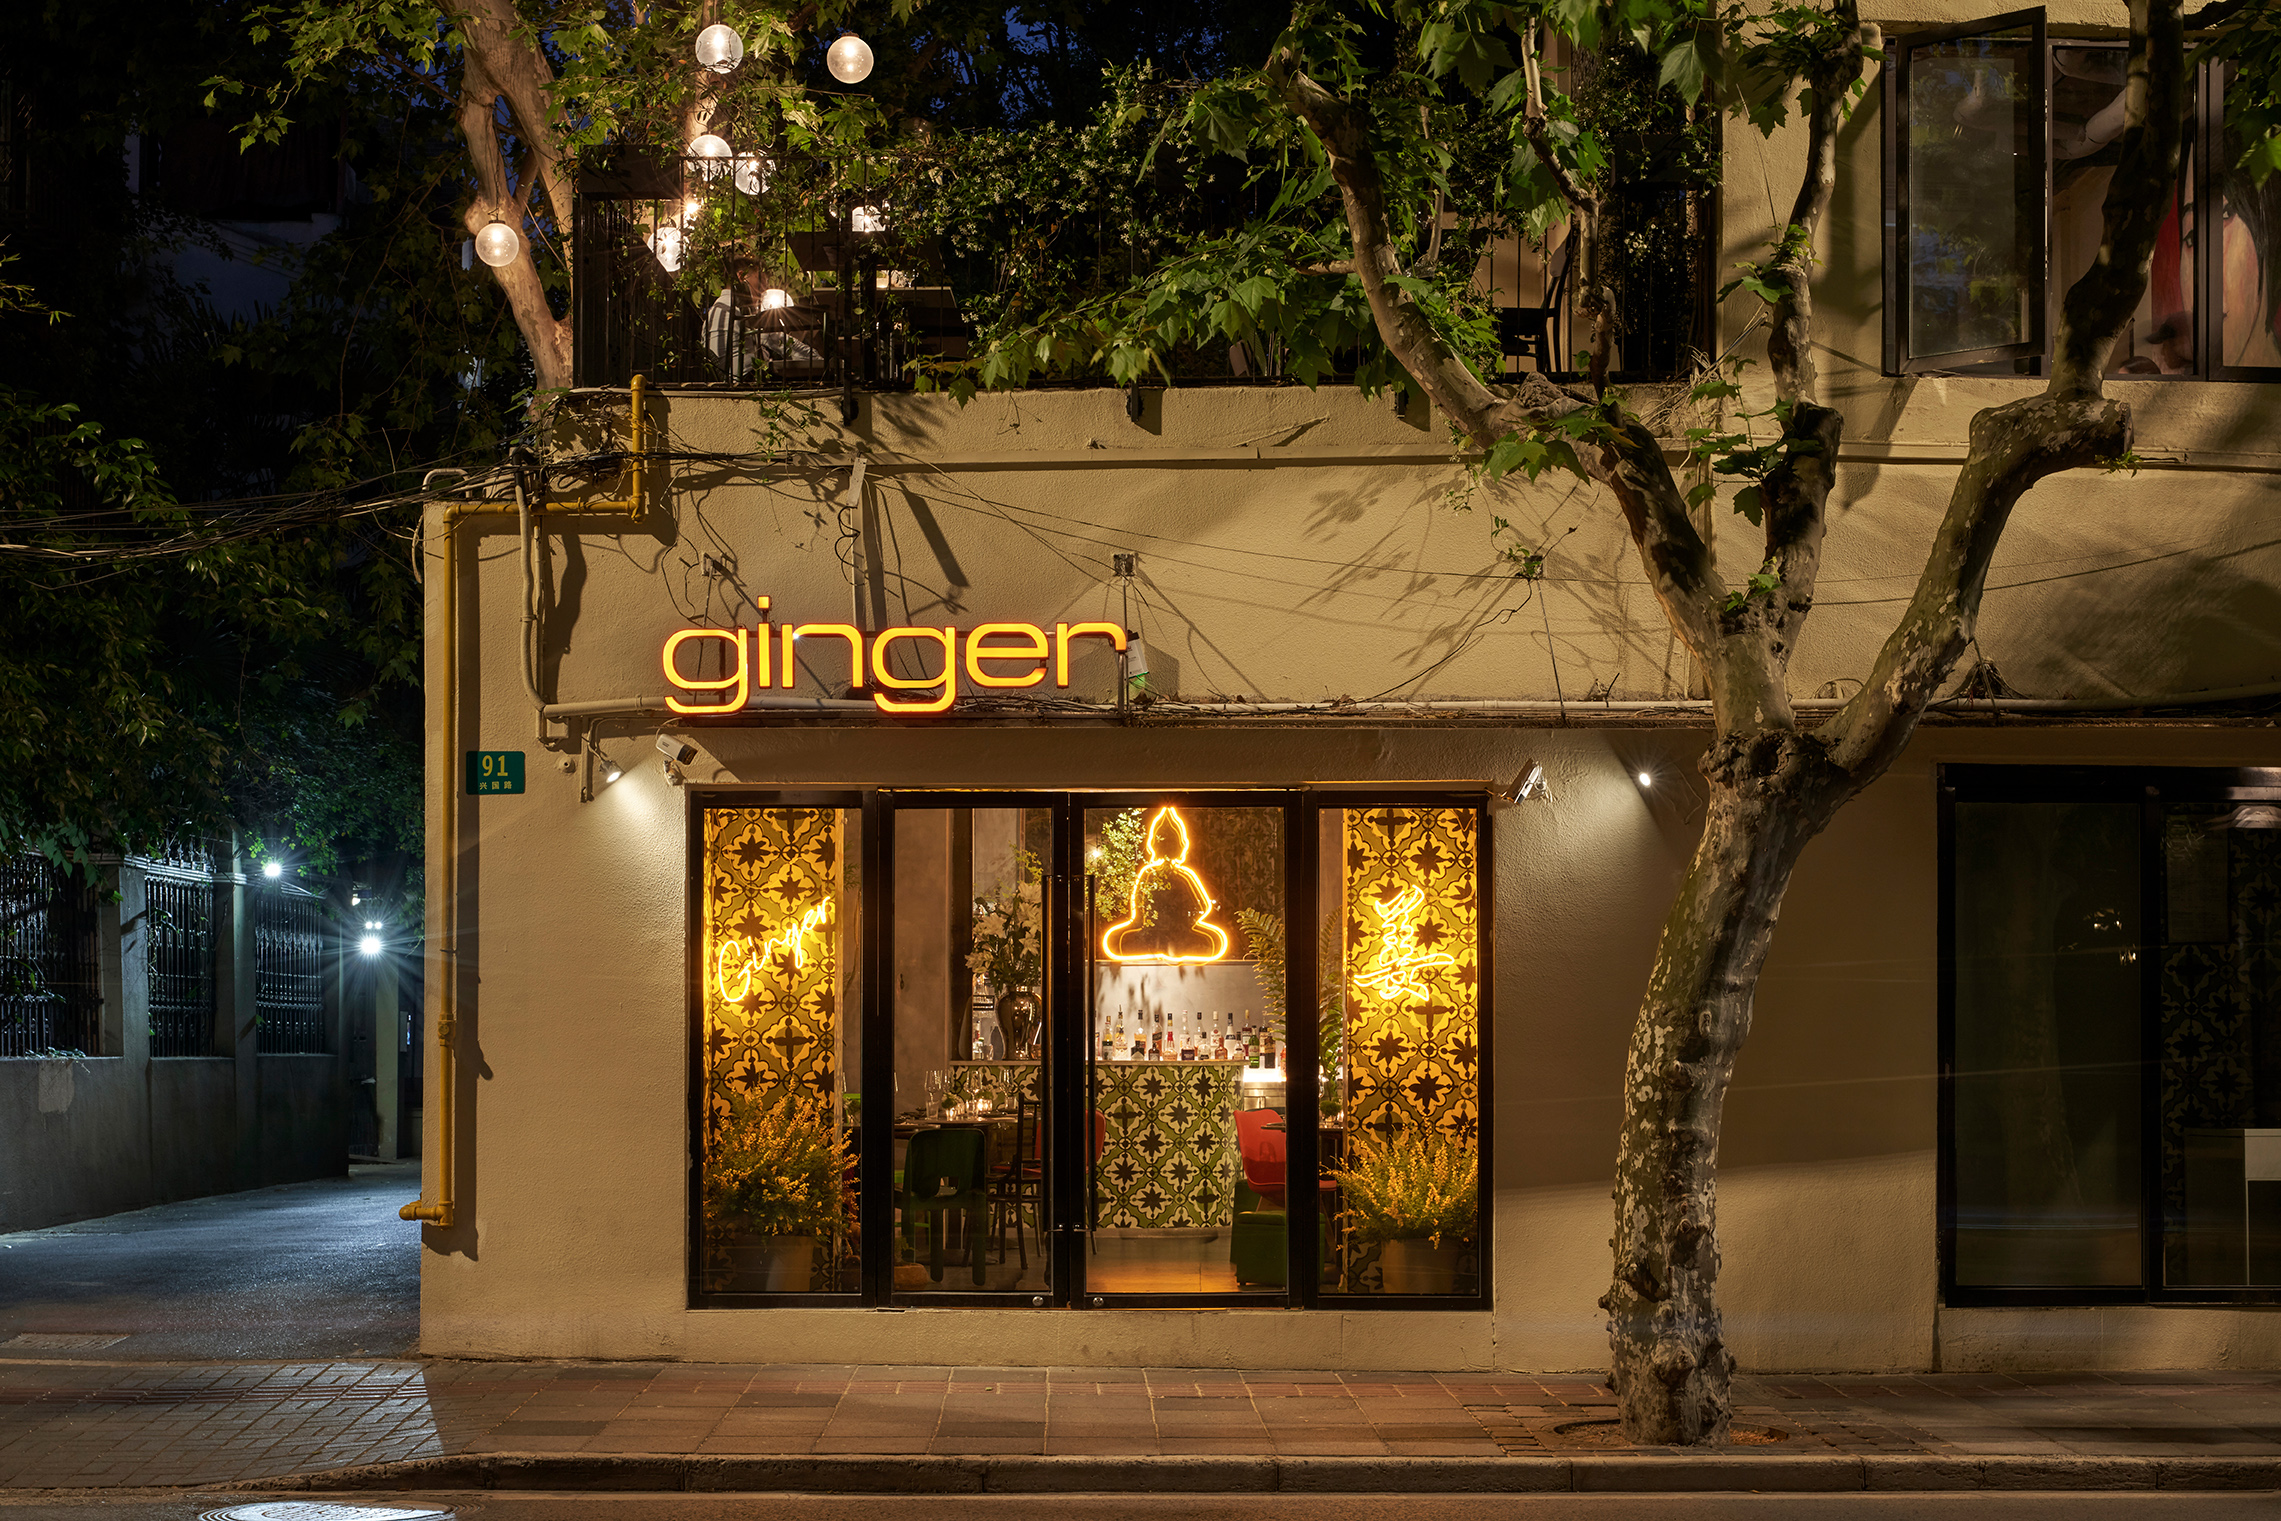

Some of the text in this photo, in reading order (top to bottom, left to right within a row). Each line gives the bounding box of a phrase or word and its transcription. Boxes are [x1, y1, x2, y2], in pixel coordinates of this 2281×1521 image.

[661, 595, 1128, 714] ginger
[480, 781, 512, 790] 兴国路
[482, 755, 508, 776] 91
[718, 896, 831, 1003] Ginger
